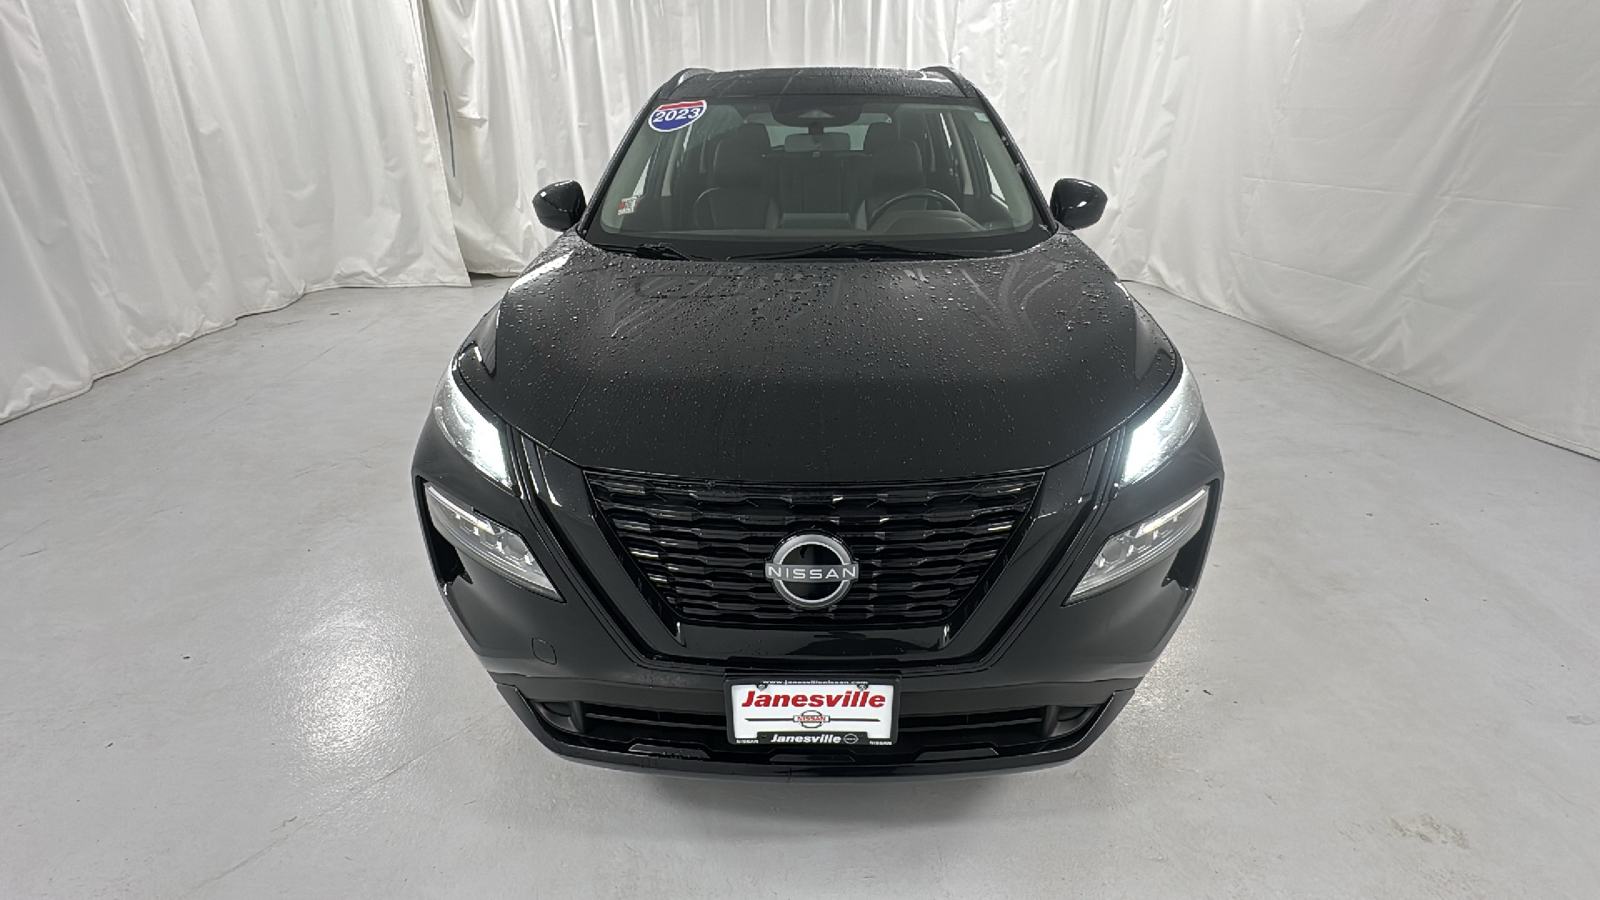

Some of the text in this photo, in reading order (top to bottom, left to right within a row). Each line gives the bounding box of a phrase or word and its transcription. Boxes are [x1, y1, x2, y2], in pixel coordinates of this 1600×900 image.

[653, 107, 701, 123] 2023
[768, 566, 856, 579] NISSAN
[741, 691, 886, 708] Janesville
[770, 733, 842, 744] Janesville
